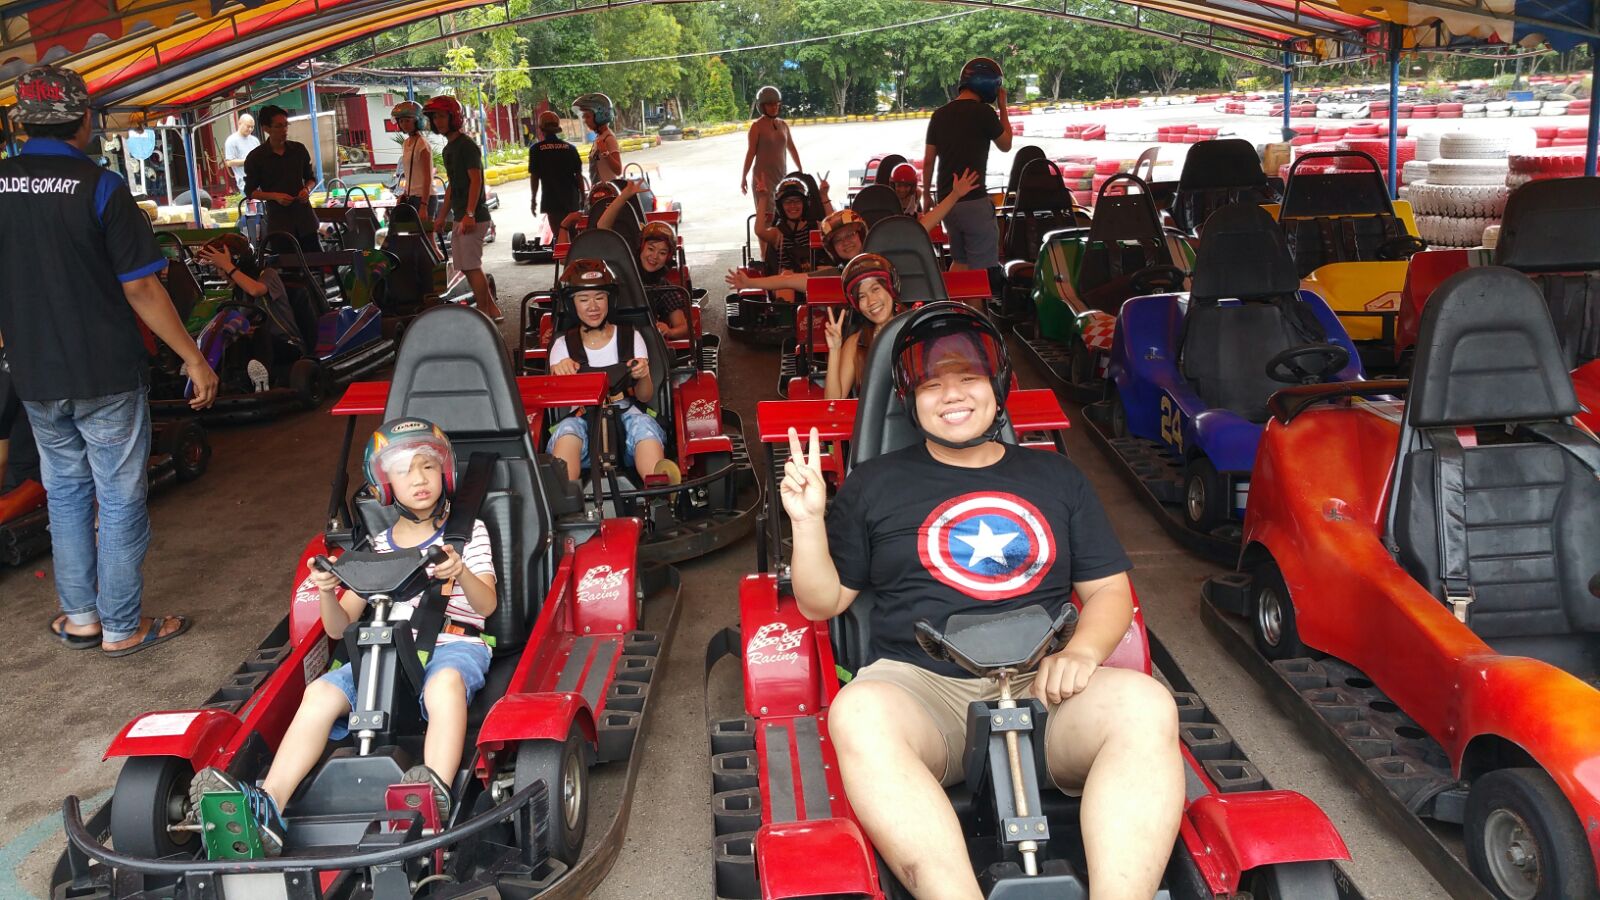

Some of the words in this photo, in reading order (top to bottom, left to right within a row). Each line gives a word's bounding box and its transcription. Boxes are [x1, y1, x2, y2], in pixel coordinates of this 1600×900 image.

[31, 178, 80, 194] GOKART
[1161, 395, 1183, 454] 24
[577, 589, 619, 603] Racing
[746, 651, 800, 665] Racing
